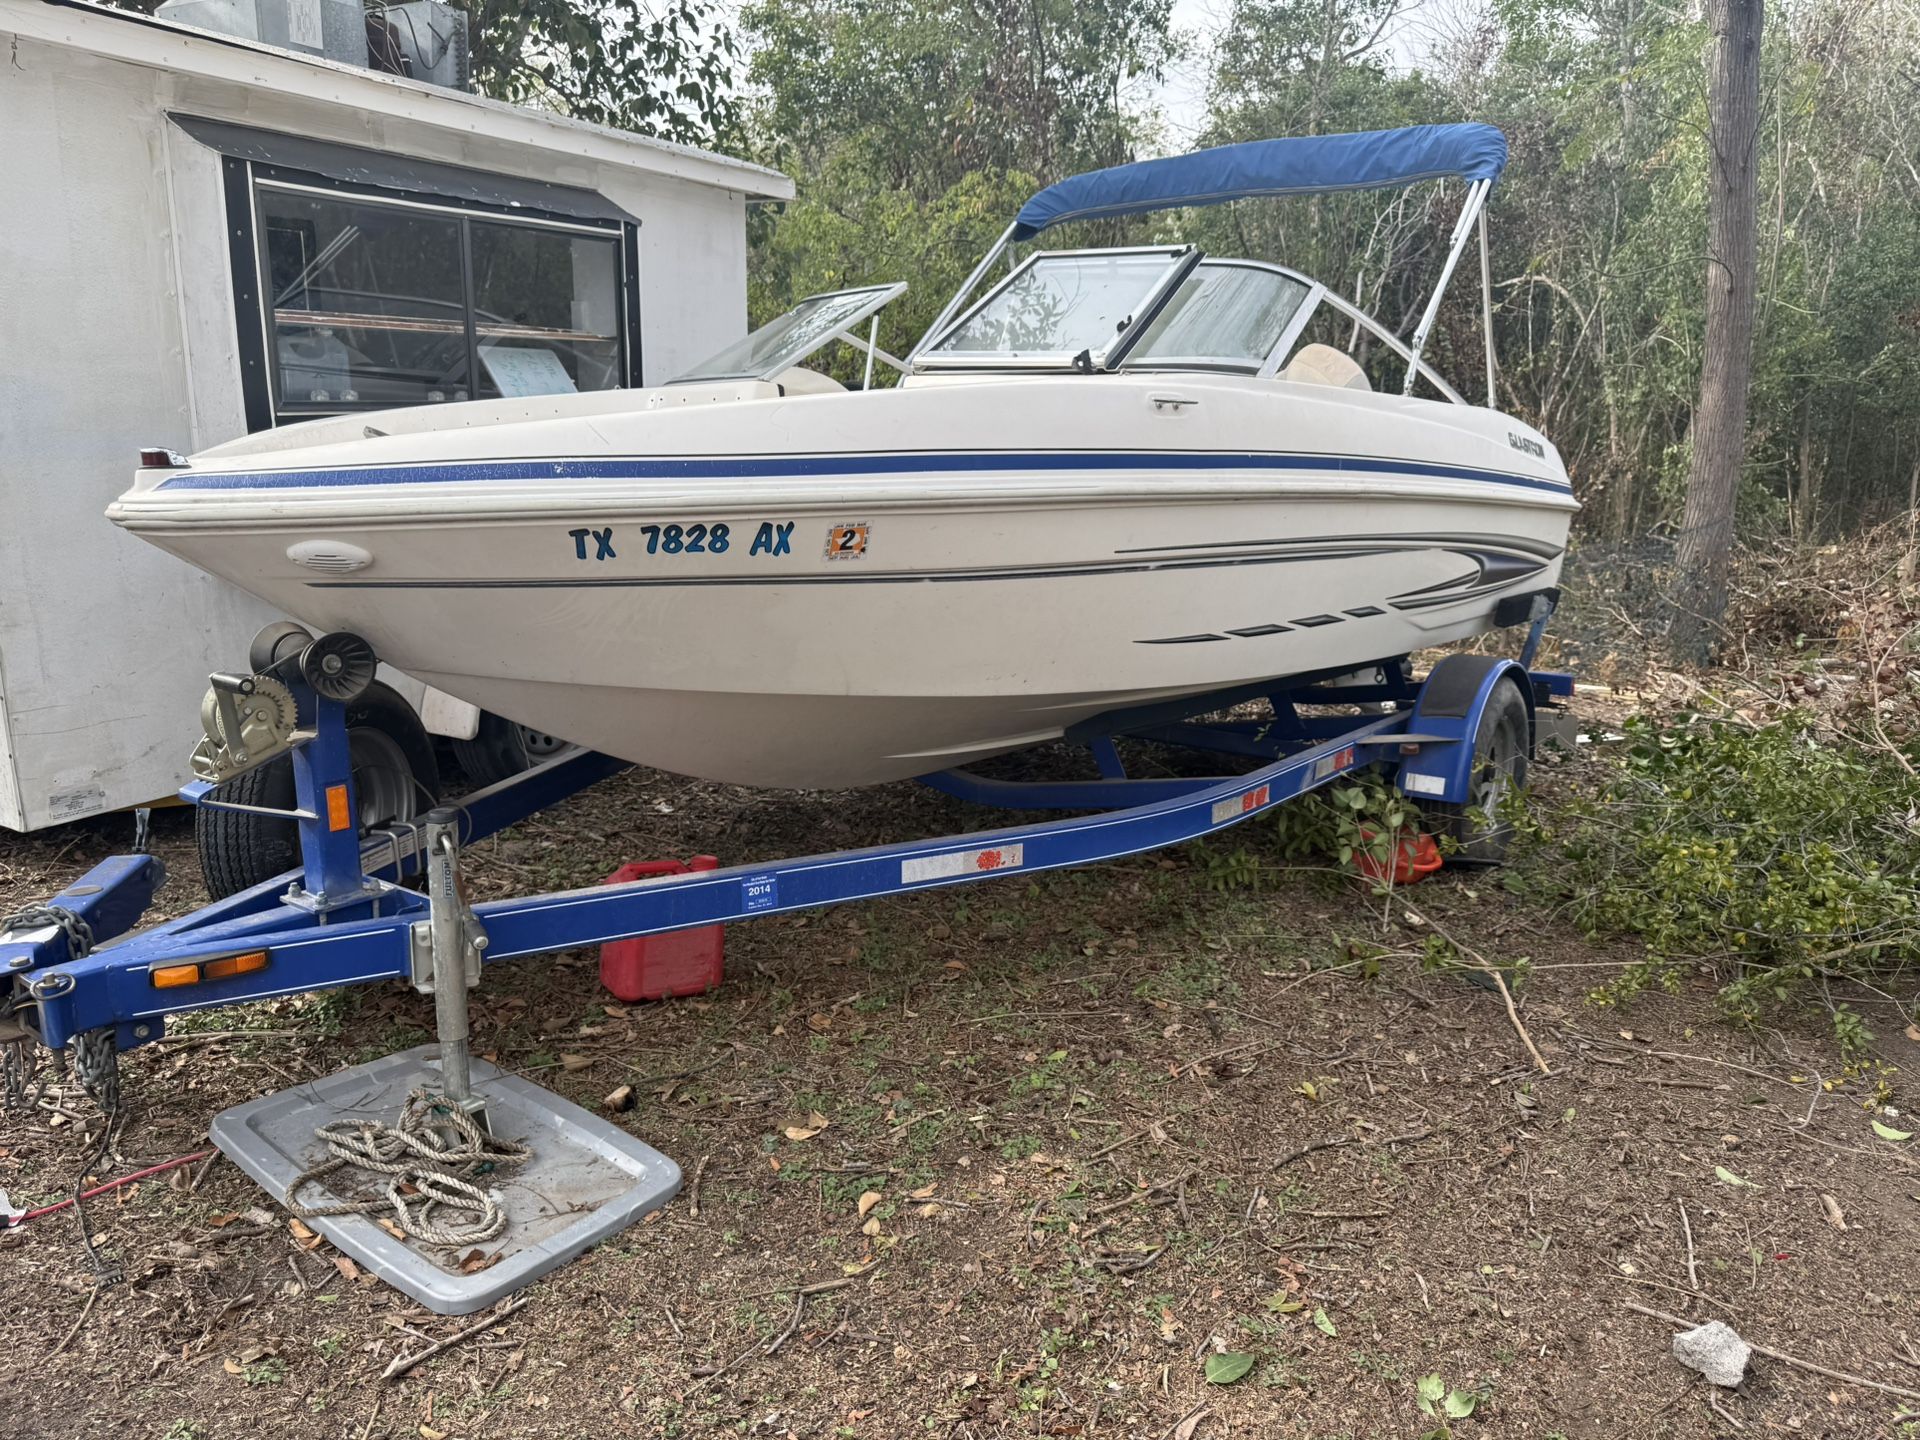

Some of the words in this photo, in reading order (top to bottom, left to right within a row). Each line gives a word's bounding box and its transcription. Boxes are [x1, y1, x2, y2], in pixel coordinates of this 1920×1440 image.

[568, 527, 616, 560] TX
[640, 523, 730, 554] 7828
[749, 521, 795, 556] AX
[839, 529, 856, 551] 2
[444, 861, 453, 897] FULTON
[748, 884, 771, 896] 2014
